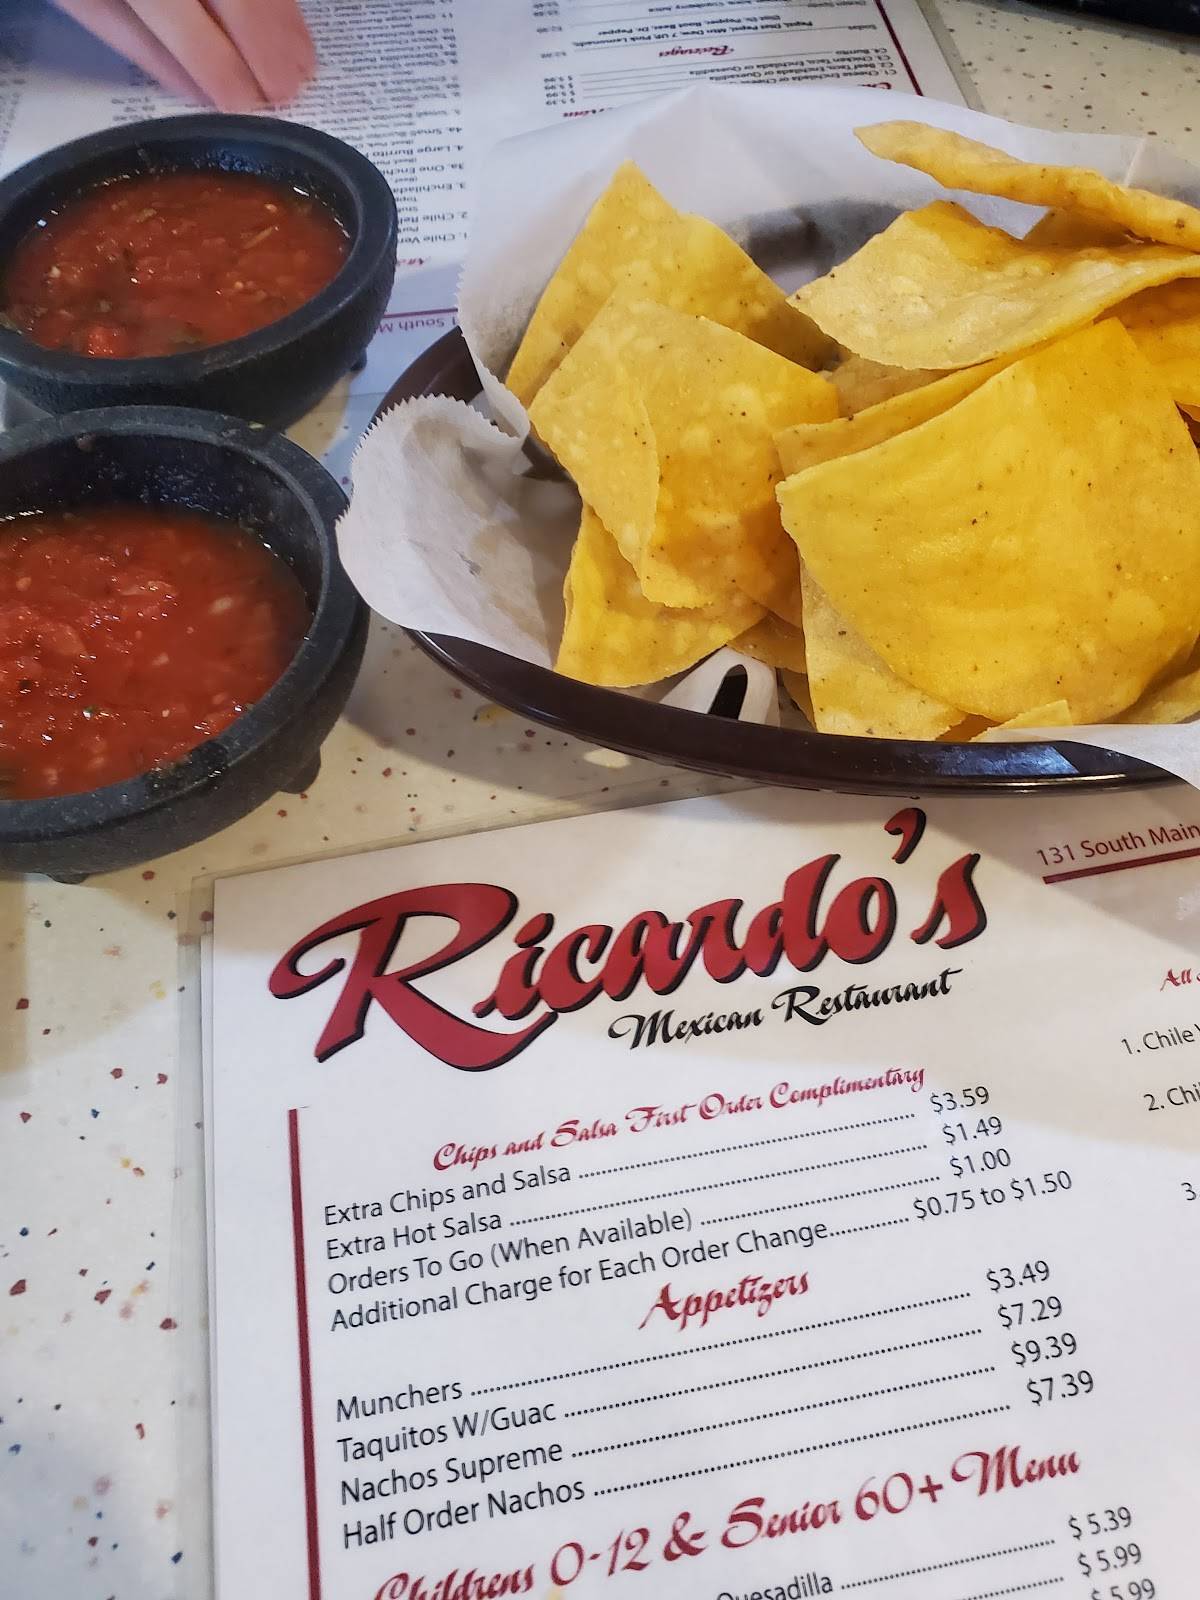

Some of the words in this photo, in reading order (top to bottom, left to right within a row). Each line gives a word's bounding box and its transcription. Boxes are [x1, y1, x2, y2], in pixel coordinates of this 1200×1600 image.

[598, 28, 633, 36] Pepper
[658, 46, 734, 58] Beverages
[832, 56, 873, 64] Chicken
[835, 48, 870, 56] Burrito
[689, 66, 742, 76] Quesadilla
[756, 60, 804, 70] Enchilada
[776, 66, 824, 76] Enchilada
[853, 62, 876, 70] Beef
[709, 71, 762, 82] Quesadilla
[792, 72, 840, 82] Enchilada
[372, 149, 414, 158] Burrito
[417, 144, 450, 154] Large
[419, 165, 444, 173] One
[422, 212, 454, 222] Chile
[422, 234, 455, 243] Chile
[399, 318, 444, 331] South
[1036, 842, 1075, 866] 131
[1080, 830, 1146, 858] South
[1148, 823, 1200, 846] Main
[269, 807, 987, 1072] Ricardo's
[1160, 968, 1192, 992] All
[608, 1008, 764, 1050] Mexican
[770, 968, 963, 1026] Restaurant
[1122, 1038, 1141, 1054] 1.
[1142, 1026, 1195, 1050] Chile
[1144, 1094, 1164, 1111] 2.
[432, 1142, 496, 1171] Chips
[502, 1131, 544, 1156] and
[550, 1119, 618, 1148] Salsa
[624, 1104, 697, 1133] First
[699, 1093, 764, 1120] Order
[770, 1066, 926, 1109] Complimentary
[324, 1200, 383, 1226] Extra
[390, 1186, 456, 1213] Chips
[462, 1172, 506, 1201] and
[514, 1165, 571, 1192] Salsa
[930, 1085, 990, 1114] $3.59
[327, 1233, 386, 1260] Extra
[394, 1222, 436, 1248] Hot
[444, 1212, 502, 1239] Salsa
[942, 1116, 1002, 1146] $1.49
[328, 1264, 409, 1295] Orders
[413, 1256, 442, 1279] To
[449, 1249, 484, 1273] Go
[491, 1235, 570, 1268] (When
[578, 1208, 692, 1250] Available)
[950, 1148, 1012, 1178] $1.00
[331, 1286, 458, 1332] Additional
[466, 1272, 553, 1307] Charge
[559, 1264, 592, 1288] for
[600, 1251, 656, 1281] Each
[662, 1237, 728, 1270] Order
[913, 1192, 974, 1221] $0.75
[980, 1187, 1006, 1205] to
[1010, 1169, 1073, 1201] $1.50
[638, 1271, 810, 1332] Appetizers
[336, 1381, 462, 1423] Munchers
[986, 1260, 1050, 1293] $3.49
[337, 1425, 448, 1463] Taquitos
[452, 1402, 557, 1438] W/Guac
[997, 1295, 1062, 1329] $7.29
[341, 1468, 438, 1506] Nachos
[445, 1442, 564, 1484] Supreme
[1011, 1332, 1077, 1368] $9.39
[343, 1512, 398, 1550] Half
[403, 1499, 480, 1536] Order
[488, 1478, 586, 1518] Nachos
[1026, 1369, 1095, 1407] $7.39
[374, 1563, 534, 1600] Childrens
[550, 1527, 650, 1587] 0-12
[663, 1511, 707, 1562] &
[720, 1495, 842, 1549] Senior
[854, 1471, 944, 1522] 60+
[950, 1444, 1082, 1497] Menu
[716, 1572, 834, 1600] Quesadilla
